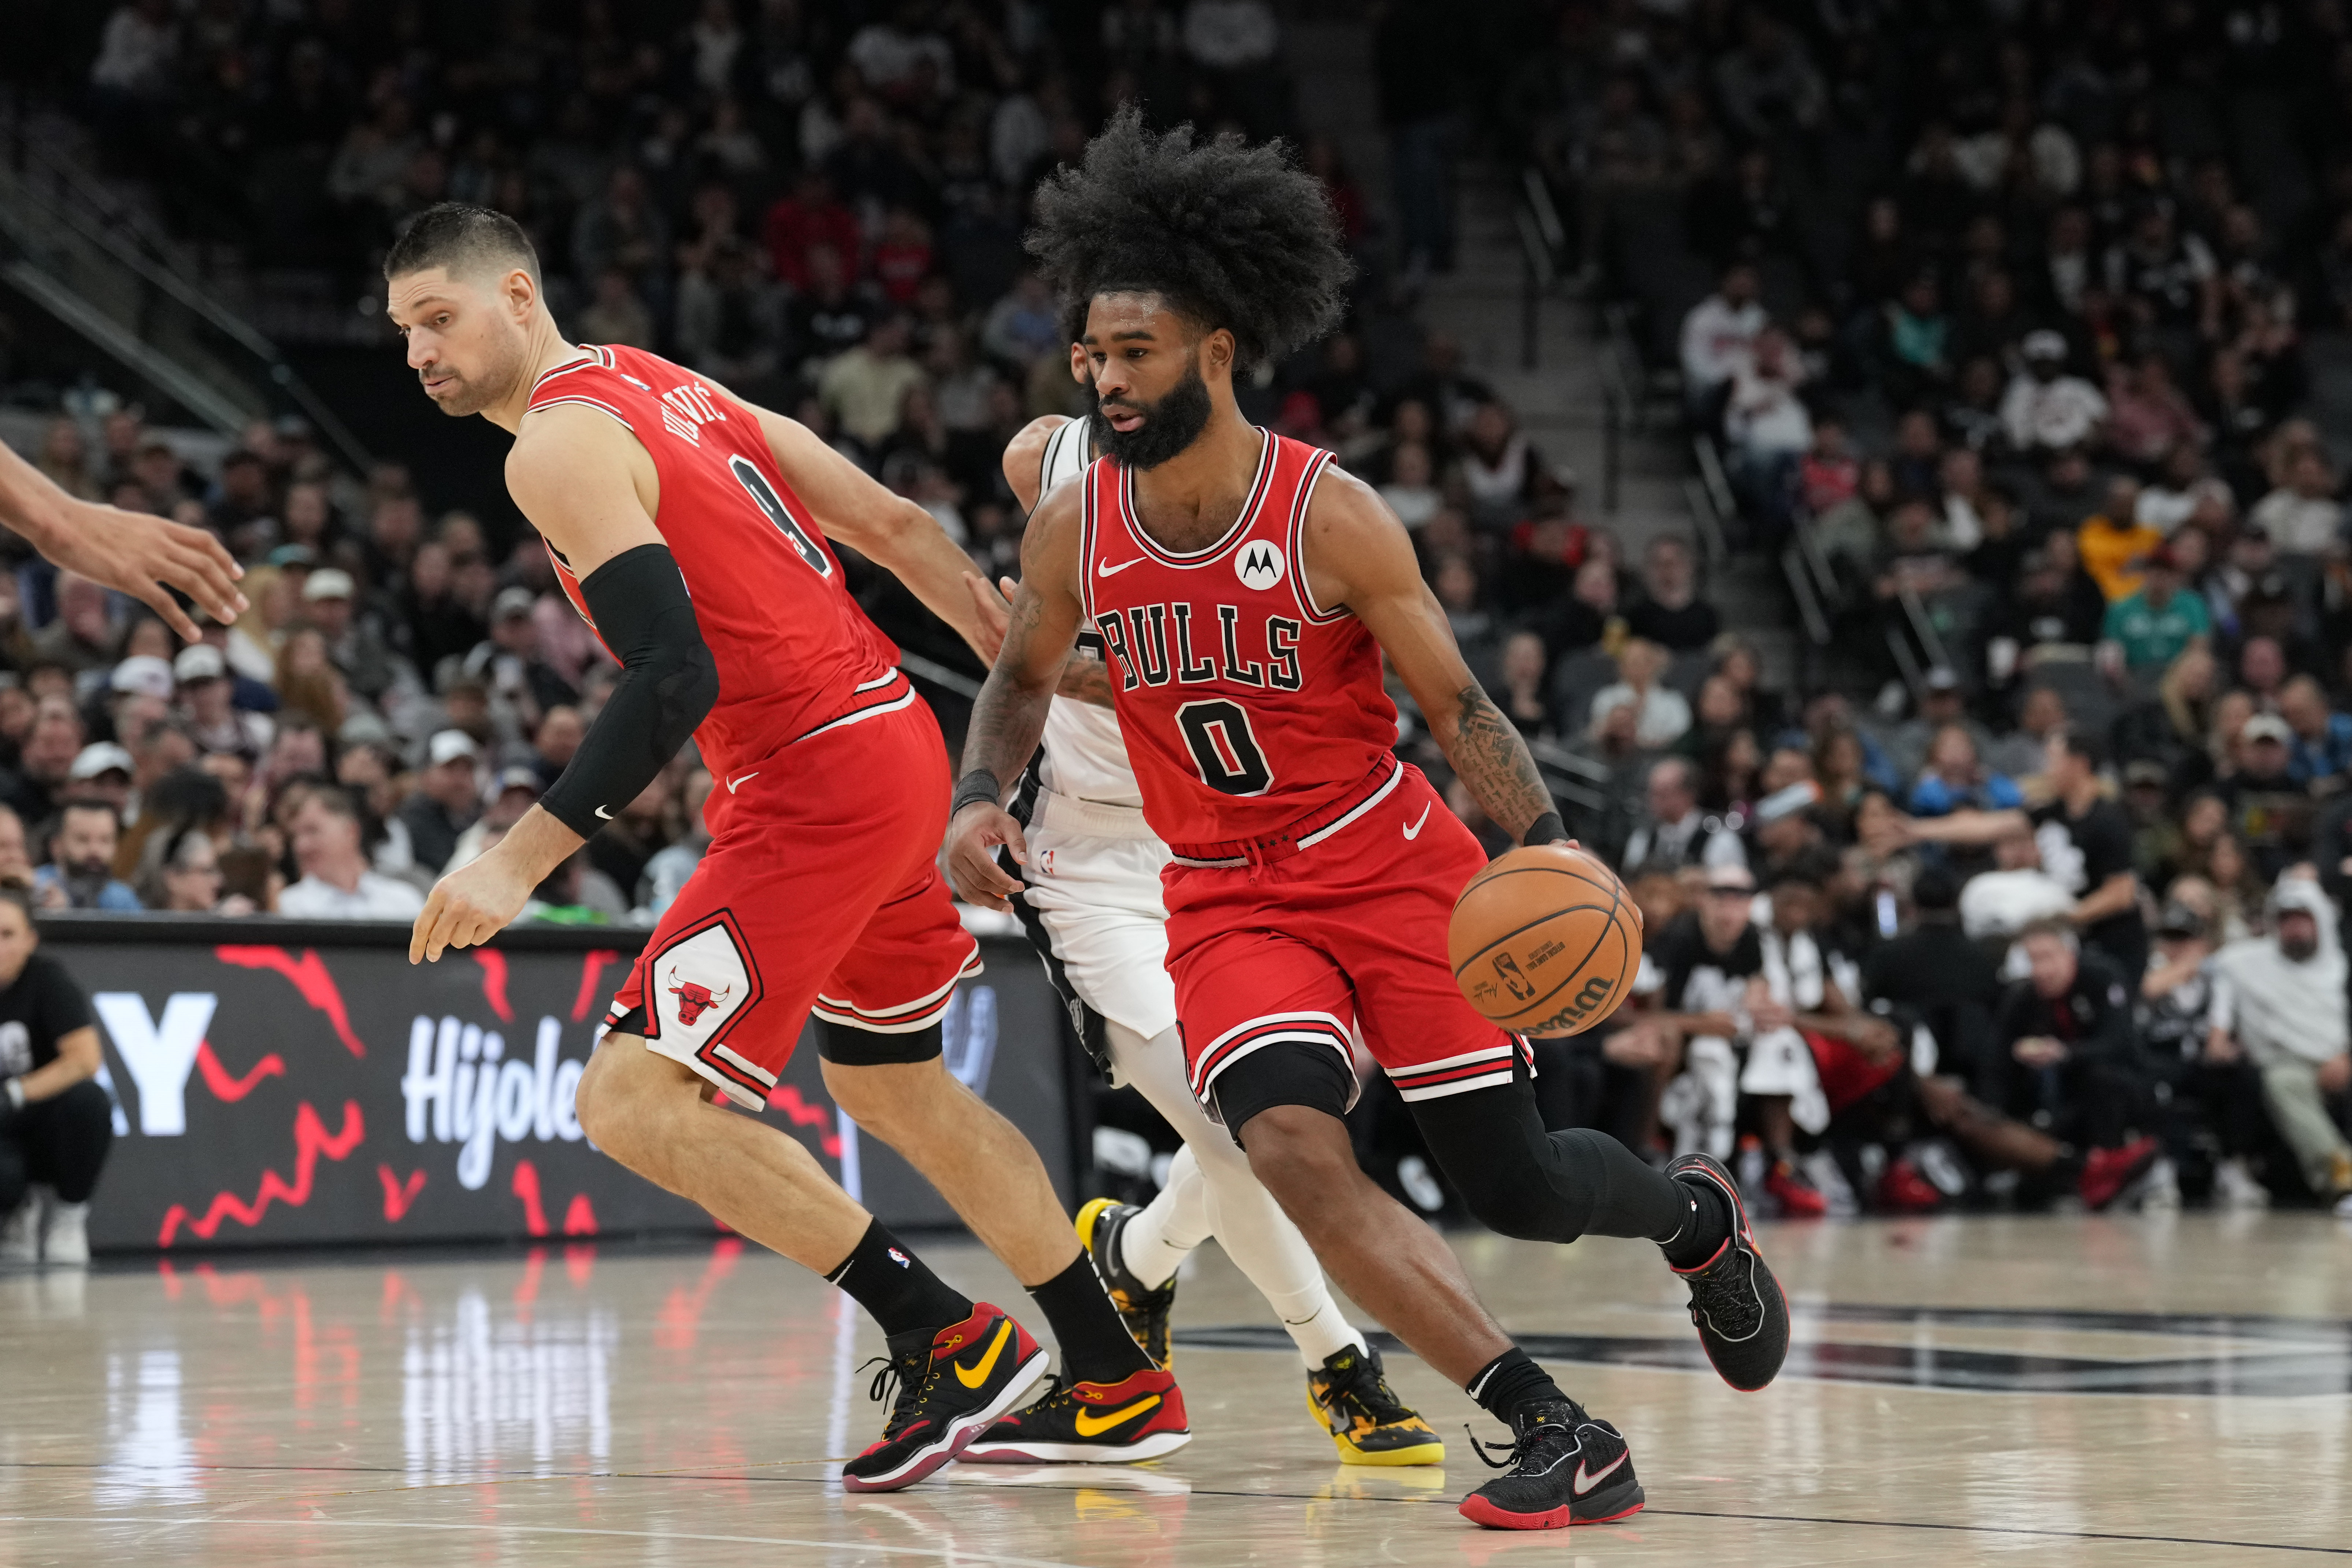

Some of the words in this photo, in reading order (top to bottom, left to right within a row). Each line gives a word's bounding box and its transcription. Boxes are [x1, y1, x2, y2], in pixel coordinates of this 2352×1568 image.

[728, 453, 833, 580] 9
[1094, 602, 1302, 693] BULLS
[1174, 697, 1275, 797] 0
[93, 991, 219, 1137] Y
